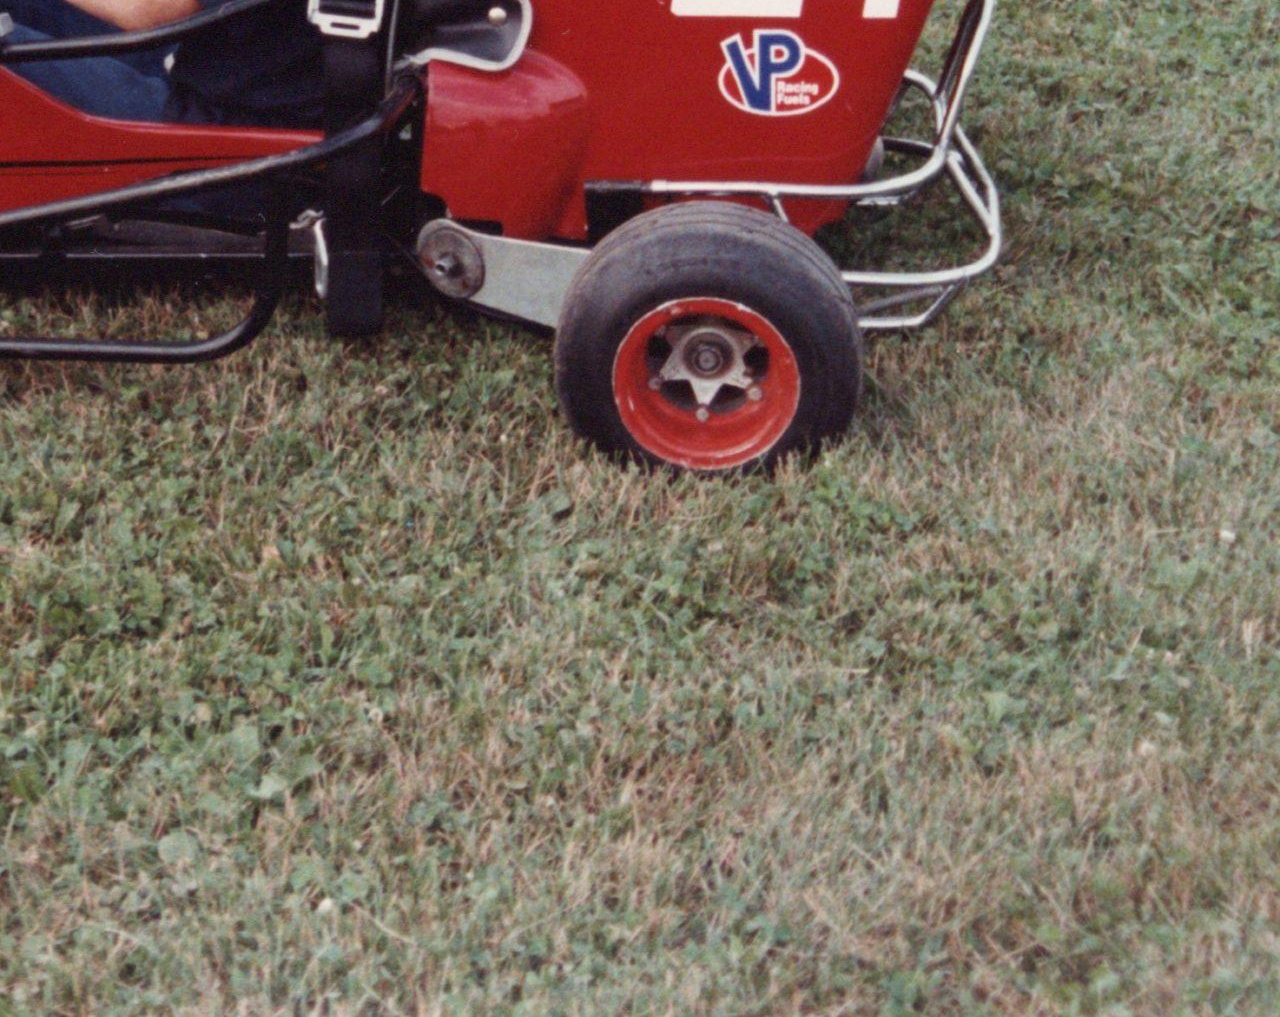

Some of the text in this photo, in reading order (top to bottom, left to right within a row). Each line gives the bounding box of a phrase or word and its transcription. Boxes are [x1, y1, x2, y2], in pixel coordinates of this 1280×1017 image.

[721, 29, 806, 113] VP
[777, 81, 819, 96] Racing
[777, 93, 811, 106] Fuels
